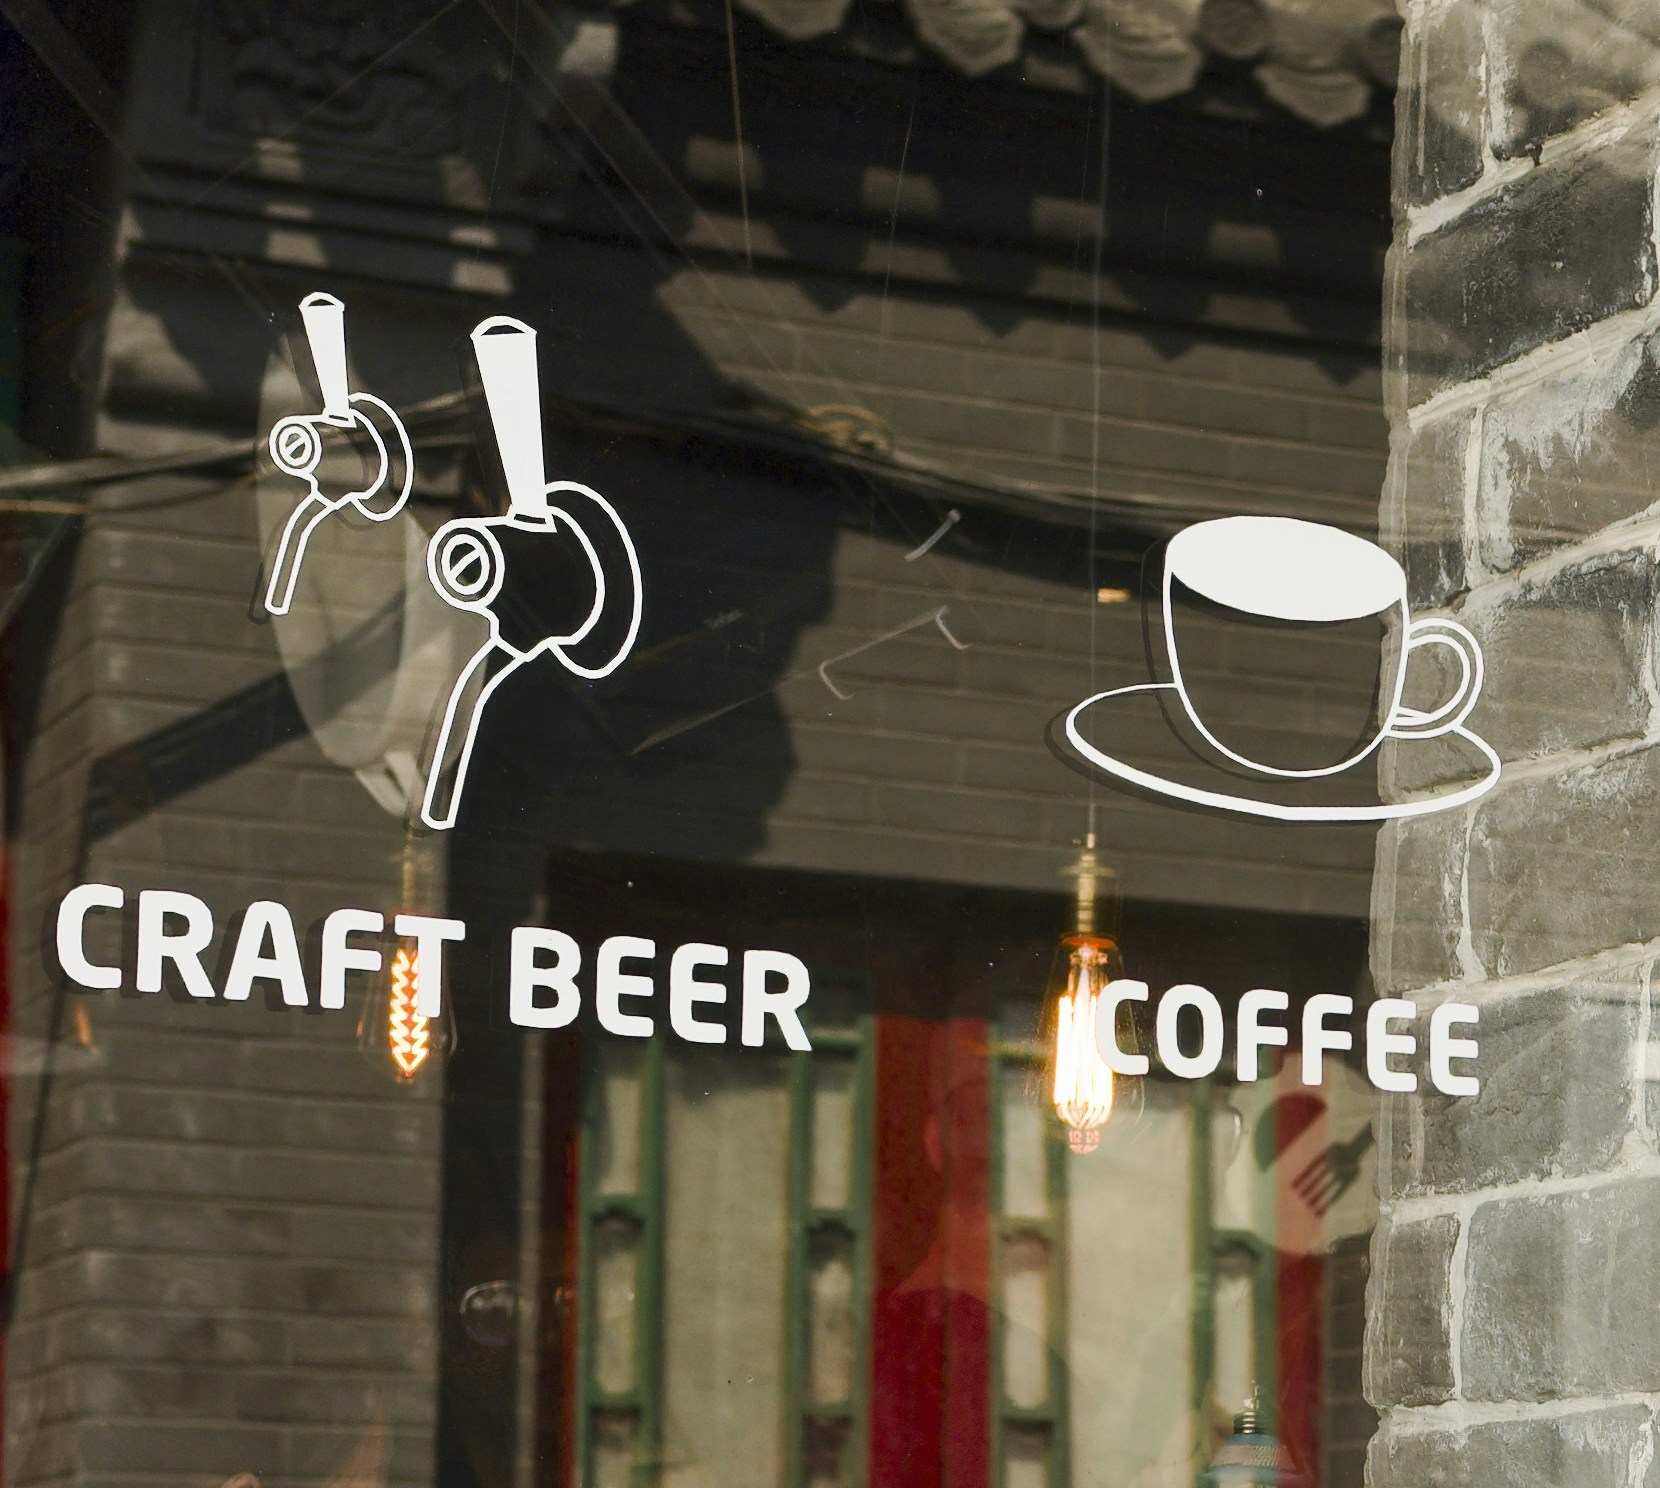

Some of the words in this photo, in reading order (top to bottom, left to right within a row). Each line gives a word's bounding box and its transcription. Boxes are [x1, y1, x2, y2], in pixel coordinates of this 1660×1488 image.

[56, 883, 466, 1018] CRAFT
[509, 926, 813, 1052] BEER
[1096, 979, 1480, 1096] COFFEE
